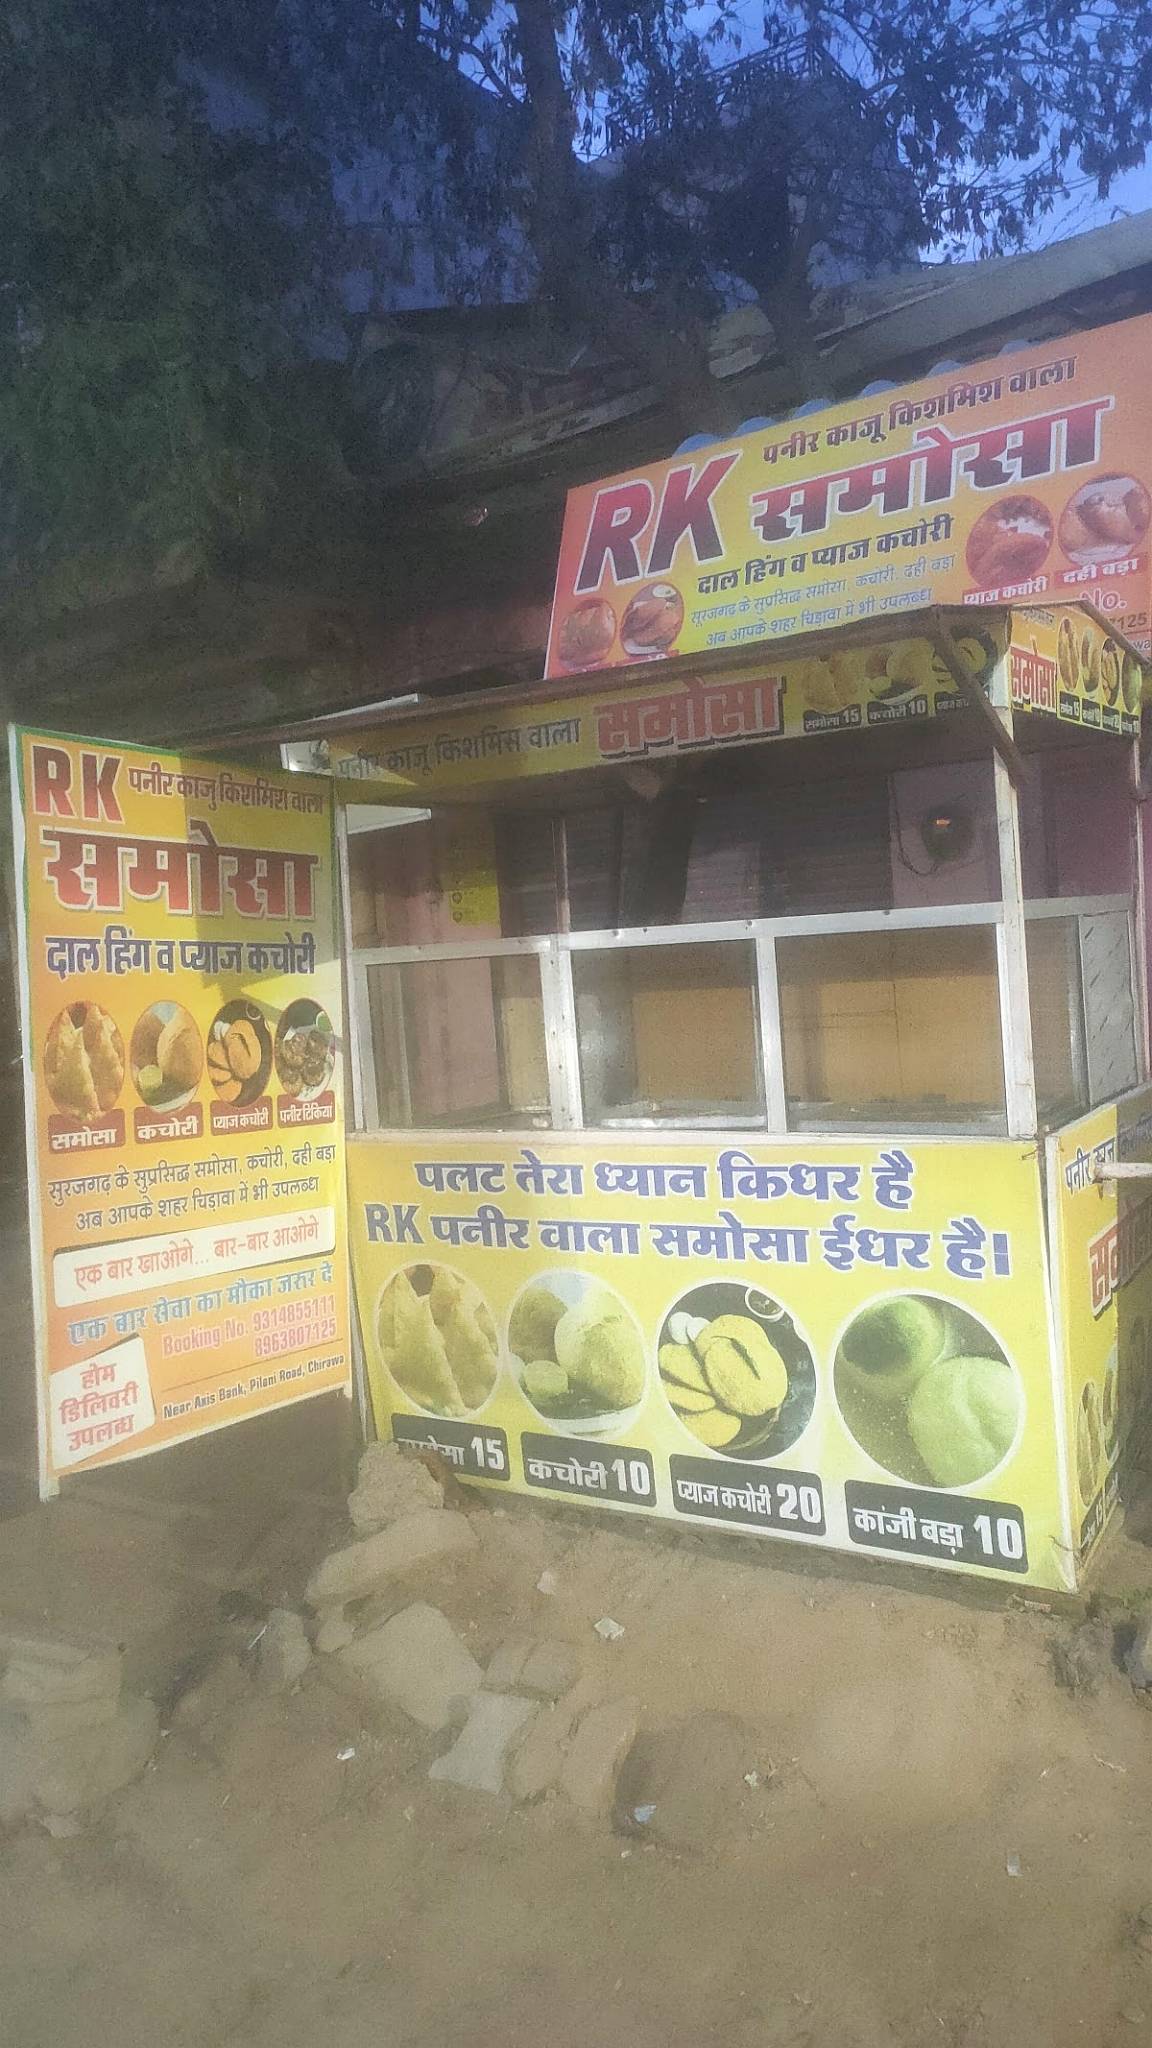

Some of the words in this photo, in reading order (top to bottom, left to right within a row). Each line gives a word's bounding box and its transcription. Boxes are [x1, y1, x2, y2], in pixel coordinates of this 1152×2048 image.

[764, 430, 821, 464] पनीर
[826, 412, 887, 445] काजू
[1008, 355, 1077, 393] वाला
[750, 396, 1113, 544] समोसा
[574, 448, 744, 594] RK
[697, 567, 741, 595] दाल
[744, 553, 785, 586] हिंग
[789, 557, 808, 573] व
[811, 536, 870, 567] प्याज
[875, 512, 954, 553] कचोरी
[769, 615, 797, 634] शहर
[527, 717, 581, 749] वाला
[592, 675, 784, 756] समोसा
[843, 708, 860, 723] 15
[908, 700, 926, 715] 10
[31, 744, 124, 824] RK
[128, 762, 174, 796] पनीर
[41, 818, 319, 919] समोसा
[45, 935, 101, 981] दाल
[103, 925, 152, 974] हिंग
[156, 939, 176, 974] व
[178, 938, 243, 974] प्याज
[247, 931, 317, 975] कचोरी
[51, 1125, 117, 1150] समोसा
[137, 1115, 199, 1140] कचोरी
[213, 1115, 238, 1129] प्याज
[239, 1107, 269, 1128] कचोरी
[280, 1105, 302, 1124] पनीर
[114, 1164, 130, 1190] के
[133, 1159, 191, 1194] सुप्रसिद्ध
[291, 1141, 312, 1166] दही
[315, 1144, 337, 1164] बड़ा
[413, 1160, 507, 1194] पलट
[512, 1149, 585, 1196] तेरा
[593, 1161, 707, 1198] ध्यान
[716, 1150, 861, 1202] किधर
[871, 1149, 914, 1210] है
[1065, 1146, 1091, 1196] पनीर
[76, 1209, 103, 1231] अब
[108, 1195, 154, 1225] आपके
[158, 1196, 189, 1217] शहर
[192, 1186, 236, 1212] चिड़ावा
[238, 1179, 249, 1203] में
[252, 1178, 269, 1201] भी
[271, 1175, 320, 1198] उपलब्ध
[74, 1263, 102, 1291] एक
[107, 1256, 134, 1281] बार
[213, 1232, 270, 1259] बार-बार
[272, 1214, 320, 1248] आओगे
[363, 1202, 424, 1245] RK
[429, 1204, 530, 1250] पनीर
[537, 1219, 642, 1256] वाला
[649, 1210, 810, 1264] समोसा
[819, 1214, 931, 1272] ईधर
[68, 1315, 107, 1345] एक
[113, 1306, 149, 1334] बार
[153, 1296, 193, 1324] सेवा
[197, 1289, 222, 1313] का
[161, 1325, 221, 1359] Booking
[223, 1316, 249, 1342] No.
[251, 1295, 336, 1333] 9314855111
[253, 1317, 337, 1358] 8963807125
[80, 1361, 118, 1390] होम
[163, 1402, 193, 1420] Near
[194, 1393, 216, 1410] Axis
[218, 1383, 247, 1401] Bank,
[249, 1371, 277, 1392] Pilani
[279, 1363, 306, 1384] Road,
[307, 1353, 345, 1374] Chirawa
[59, 1380, 140, 1425] डिलिवरी
[66, 1413, 135, 1452] उपलब्ध
[470, 1435, 505, 1471] 15
[527, 1456, 608, 1491] कचोरी
[611, 1457, 651, 1496] 10
[676, 1479, 719, 1507] प्याज
[719, 1482, 772, 1517] कचोरी
[775, 1482, 823, 1524] 20
[852, 1503, 917, 1541] कांजी
[919, 1517, 964, 1556] बड़ा
[973, 1514, 1024, 1561] 10
